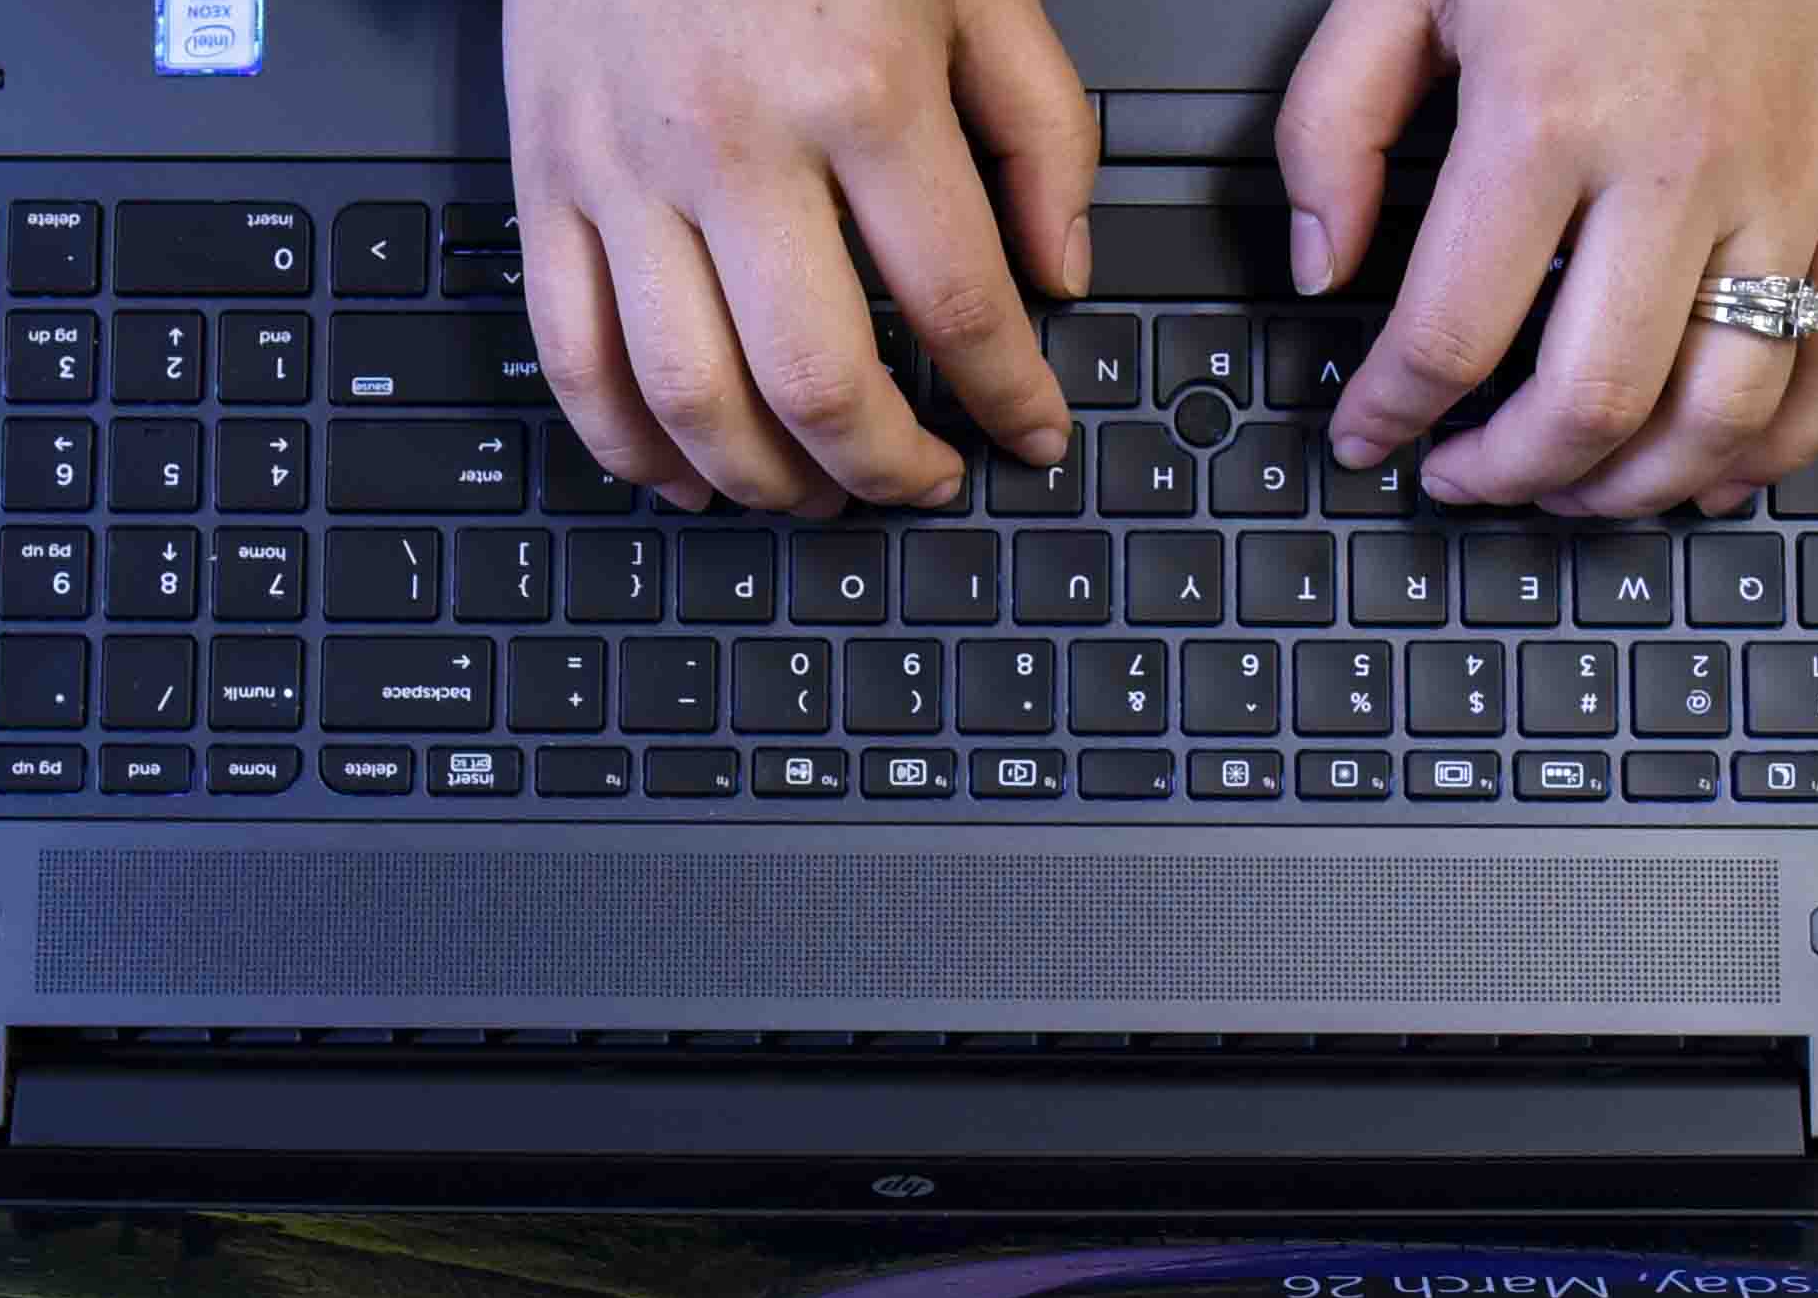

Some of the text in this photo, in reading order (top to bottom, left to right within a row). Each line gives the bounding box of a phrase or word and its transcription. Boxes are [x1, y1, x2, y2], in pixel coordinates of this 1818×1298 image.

[27, 212, 81, 228] delete
[247, 213, 294, 228] insert
[274, 247, 294, 270] 0
[28, 327, 78, 345] pg dn
[259, 330, 292, 345] end
[59, 355, 76, 379] 3
[166, 356, 183, 379] 2
[276, 356, 286, 379] 1
[502, 361, 538, 377] shift
[1098, 358, 1119, 382] N
[1210, 352, 1230, 376] B
[1320, 360, 1341, 382] V
[55, 463, 74, 486] 6
[163, 463, 180, 486] 5
[271, 464, 289, 486] 4
[459, 469, 503, 484] enter
[1048, 466, 1063, 490] J
[1153, 466, 1174, 490] H
[1263, 466, 1286, 490] G
[1381, 468, 1398, 491] F
[21, 543, 72, 558] pg up
[238, 546, 287, 562] home
[53, 571, 71, 595] 9
[160, 571, 178, 595] 8
[269, 573, 285, 595] 7
[734, 574, 753, 598] P
[840, 575, 865, 599] O
[971, 575, 978, 598] I
[1069, 575, 1090, 599] U
[1180, 575, 1201, 599] Y
[1297, 576, 1317, 600] T
[1407, 576, 1427, 600] R
[1520, 576, 1539, 600] E
[1617, 576, 1651, 600] W
[1739, 576, 1764, 601] Q
[790, 652, 810, 675] 0
[903, 652, 921, 676] 9
[1016, 652, 1034, 676] 8
[1129, 653, 1145, 676] 7
[1241, 653, 1260, 677] 6
[1353, 653, 1370, 677] 5
[1466, 654, 1484, 676] 4
[1579, 654, 1596, 677] 3
[1693, 655, 1709, 678] 2
[381, 684, 471, 702] backspace
[11, 760, 63, 775] pg up
[128, 763, 162, 778] end
[228, 763, 277, 778] home
[344, 762, 398, 778] delete
[447, 772, 495, 787] insert
[1283, 1275, 1363, 1298] 26
